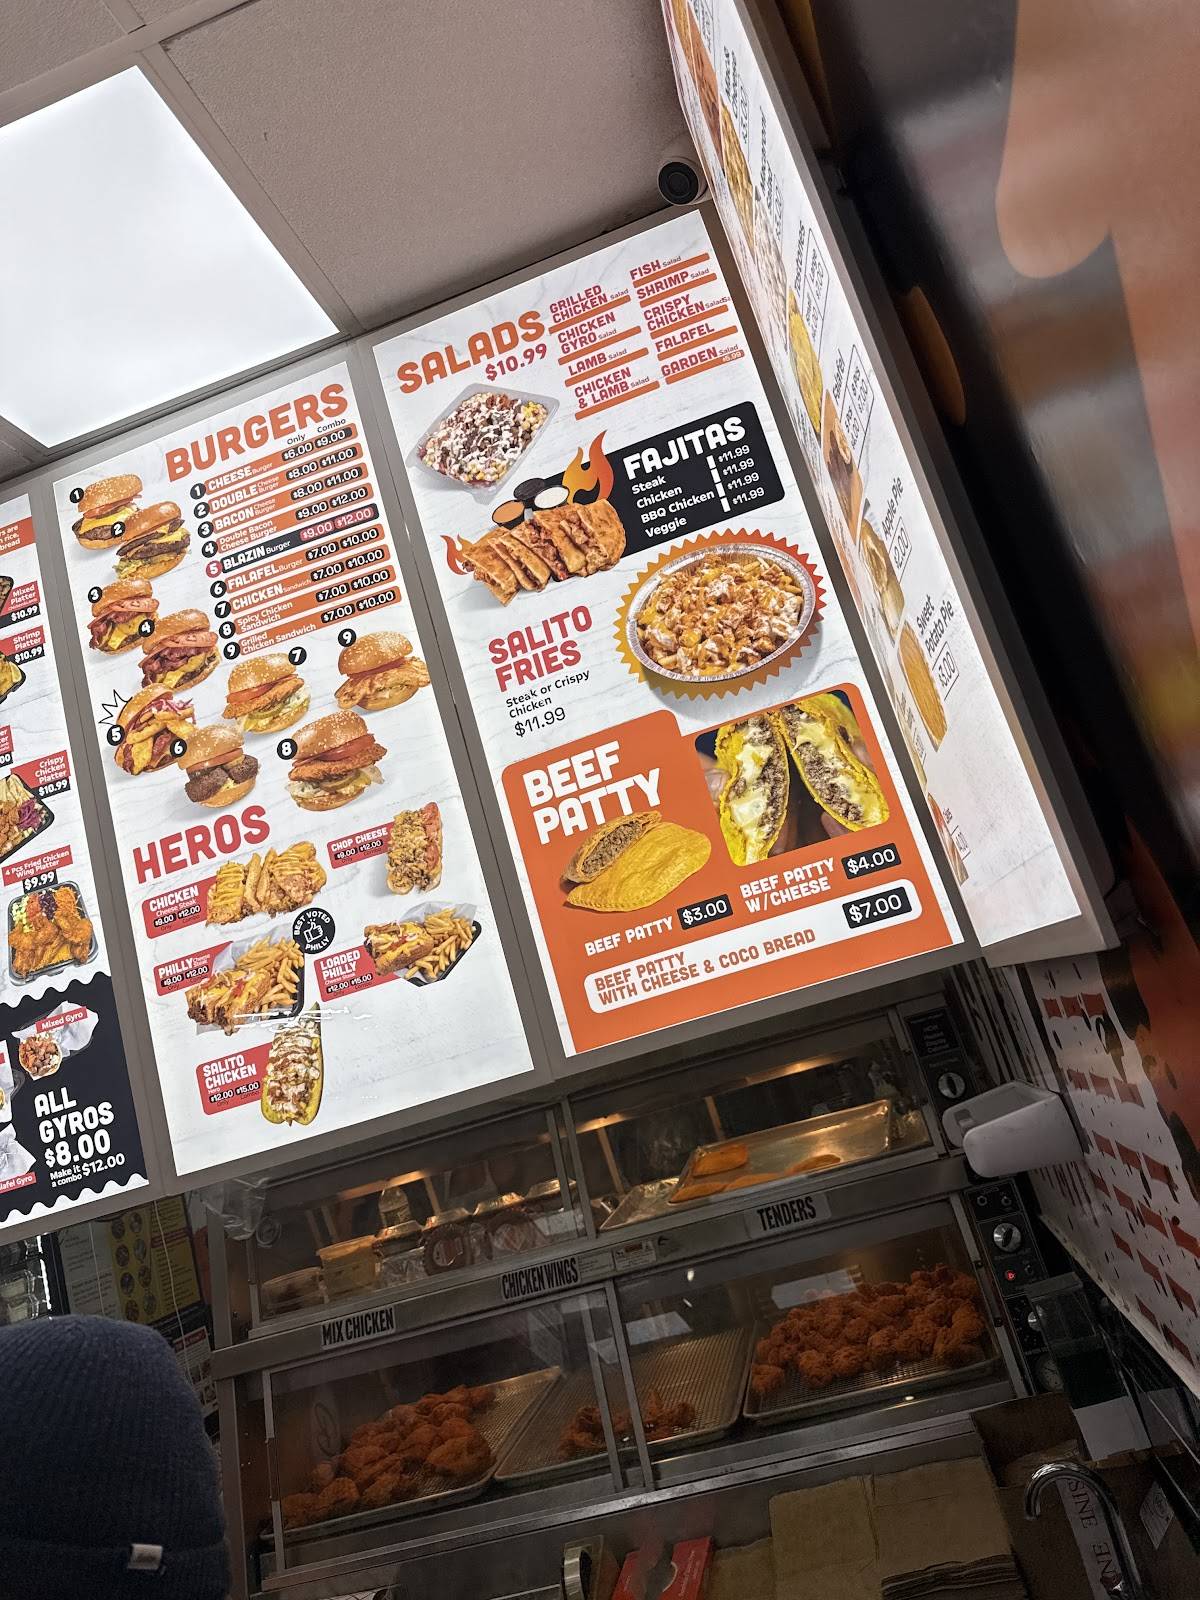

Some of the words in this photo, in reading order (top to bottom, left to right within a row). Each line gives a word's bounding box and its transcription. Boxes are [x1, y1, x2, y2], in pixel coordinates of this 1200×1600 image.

[629, 259, 661, 280] FISH
[661, 255, 681, 267] Salad
[794, 216, 805, 298] Tostones
[548, 284, 602, 313] GRILLED
[635, 270, 690, 299] SHRIMP
[689, 267, 709, 279] Salad
[551, 293, 608, 323] CHICKEN
[609, 287, 629, 300] Salad
[643, 293, 692, 320] CRISPY
[646, 300, 705, 331] CHICKEN
[557, 311, 616, 343] CHICKEN
[560, 331, 597, 354] GYRO
[597, 328, 617, 340] Salad
[654, 321, 715, 352] FALAFEL
[394, 309, 546, 394] SALADS
[484, 342, 549, 381] $10.99
[567, 352, 607, 375] LAMB
[607, 348, 627, 360] Salad
[660, 346, 718, 376] GARDEN
[718, 343, 739, 355] Salad
[573, 366, 632, 397] CHICKEN
[577, 397, 588, 409] &
[591, 380, 629, 403] LAMB
[630, 376, 650, 388] Salad
[831, 349, 845, 404] Falafel
[164, 382, 349, 480] BURGERS
[286, 432, 306, 446] Only
[316, 416, 346, 434] Combo
[622, 414, 746, 480] FAJITAS
[207, 465, 252, 491] CHEESE
[283, 442, 312, 460] $6.00
[316, 429, 346, 448] $9.00
[631, 474, 666, 495] Steak
[717, 444, 750, 463] $11.99
[211, 484, 258, 511] DOUBLE
[288, 461, 317, 479] $8.00
[321, 448, 353, 467] $11.00
[635, 484, 682, 509] Chicken
[721, 457, 755, 476] $11.99
[214, 506, 254, 530] BACON
[292, 481, 322, 499] $8.00
[326, 467, 359, 487] $11.00
[640, 506, 667, 524] BBQ
[667, 488, 715, 514] Chicken
[726, 471, 760, 491] $11.99
[645, 514, 688, 540] Veggie
[731, 486, 765, 506] $11.99
[881, 495, 897, 542] Apple
[891, 472, 903, 505] Pie
[219, 528, 247, 544] Double
[248, 519, 273, 533] Bacon
[297, 500, 327, 519] $9.00
[331, 487, 366, 507] $12.00
[220, 535, 249, 551] Cheese
[250, 525, 278, 542] Burger
[222, 545, 265, 570] BLAZIN
[265, 539, 291, 555] Burger
[302, 520, 333, 539] $9.00
[336, 507, 371, 528] $12.00
[892, 527, 908, 570] $2.00
[227, 562, 279, 590] FALAFEL
[307, 541, 338, 560] $7.00
[342, 527, 377, 548] $10.00
[12, 583, 34, 598] Mixed
[232, 582, 283, 611] CHICKEN
[312, 562, 343, 581] $7.00
[347, 548, 383, 569] $10.00
[10, 590, 36, 606] Platter
[11, 604, 38, 622] $10.99
[237, 612, 260, 627] Spicy
[260, 600, 293, 618] Chicken
[317, 583, 348, 601] $7.00
[352, 569, 388, 590] $10.00
[916, 592, 934, 635] Sweet
[240, 631, 267, 647] Grilled
[322, 604, 354, 623] $7.00
[358, 590, 394, 611] $10.00
[241, 612, 281, 633] Sandwich
[486, 604, 593, 665] SALITO
[924, 613, 944, 658] Potato
[940, 595, 953, 626] Pie
[12, 628, 40, 645] Shrimp
[14, 635, 41, 651] Platter
[242, 636, 274, 654] Chicken
[274, 621, 316, 643] Sandwich
[14, 644, 42, 663] $10.99
[495, 638, 582, 691] FRIES
[937, 650, 955, 690] $3.00
[505, 688, 538, 708] Steak
[539, 684, 553, 694] or
[554, 668, 591, 690] Crispy
[508, 695, 552, 718] Chicken
[513, 705, 567, 738] $11.99
[34, 760, 65, 778] Chicken
[39, 754, 64, 770] Crispy
[39, 769, 66, 785] Platter
[522, 741, 626, 806] BEEF
[38, 778, 68, 797] $10.99
[532, 768, 668, 843] PATTY
[132, 802, 271, 882] HEROS
[331, 838, 354, 852] CHOP
[355, 826, 388, 844] CHEESE
[11, 864, 23, 875] Pcs
[24, 858, 41, 870] Fried
[43, 848, 69, 863] Chicken
[15, 867, 34, 880] Wing
[34, 858, 59, 872] Platter
[739, 874, 781, 898] BEEF
[783, 856, 837, 885] PATTY
[23, 870, 55, 891] $9.99
[744, 875, 831, 915] W/CHEESE
[846, 846, 896, 875] $4.00
[148, 884, 199, 912] CHICKEN
[291, 915, 307, 935] BEST
[306, 906, 330, 928] VOTED
[584, 932, 623, 956] BEEF
[624, 916, 675, 943] PATTY
[681, 897, 728, 926] $3.00
[304, 935, 330, 952] PHILLY
[594, 968, 634, 991] BEEF
[636, 951, 687, 978] PATTY
[847, 891, 903, 924] $7.00
[158, 957, 194, 978] PHILLY
[319, 949, 361, 970] LOADED
[322, 960, 358, 980] PHILLY
[598, 982, 638, 1006] WITH
[640, 963, 699, 993] CHEESE
[702, 958, 715, 974] &
[718, 944, 760, 969] COCO
[762, 927, 816, 956] BREAD
[41, 1016, 64, 1030] Mixed
[64, 1010, 84, 1024] Gyro
[202, 1054, 245, 1077] SALITO
[204, 1063, 257, 1090] CHICKEN
[33, 1084, 77, 1117] ALL
[37, 1100, 115, 1144] GYROS
[43, 1127, 112, 1170] $8.00
[15, 1174, 33, 1186] Gyro
[49, 1165, 73, 1180] Make
[56, 1171, 82, 1186] combo
[81, 1152, 126, 1177] $12.00
[756, 1196, 818, 1232] TENDERS
[502, 1265, 545, 1300] CHICKEN
[543, 1257, 579, 1291] WINGS
[321, 1322, 345, 1346] MIX
[345, 1309, 395, 1341] CHICKEN
